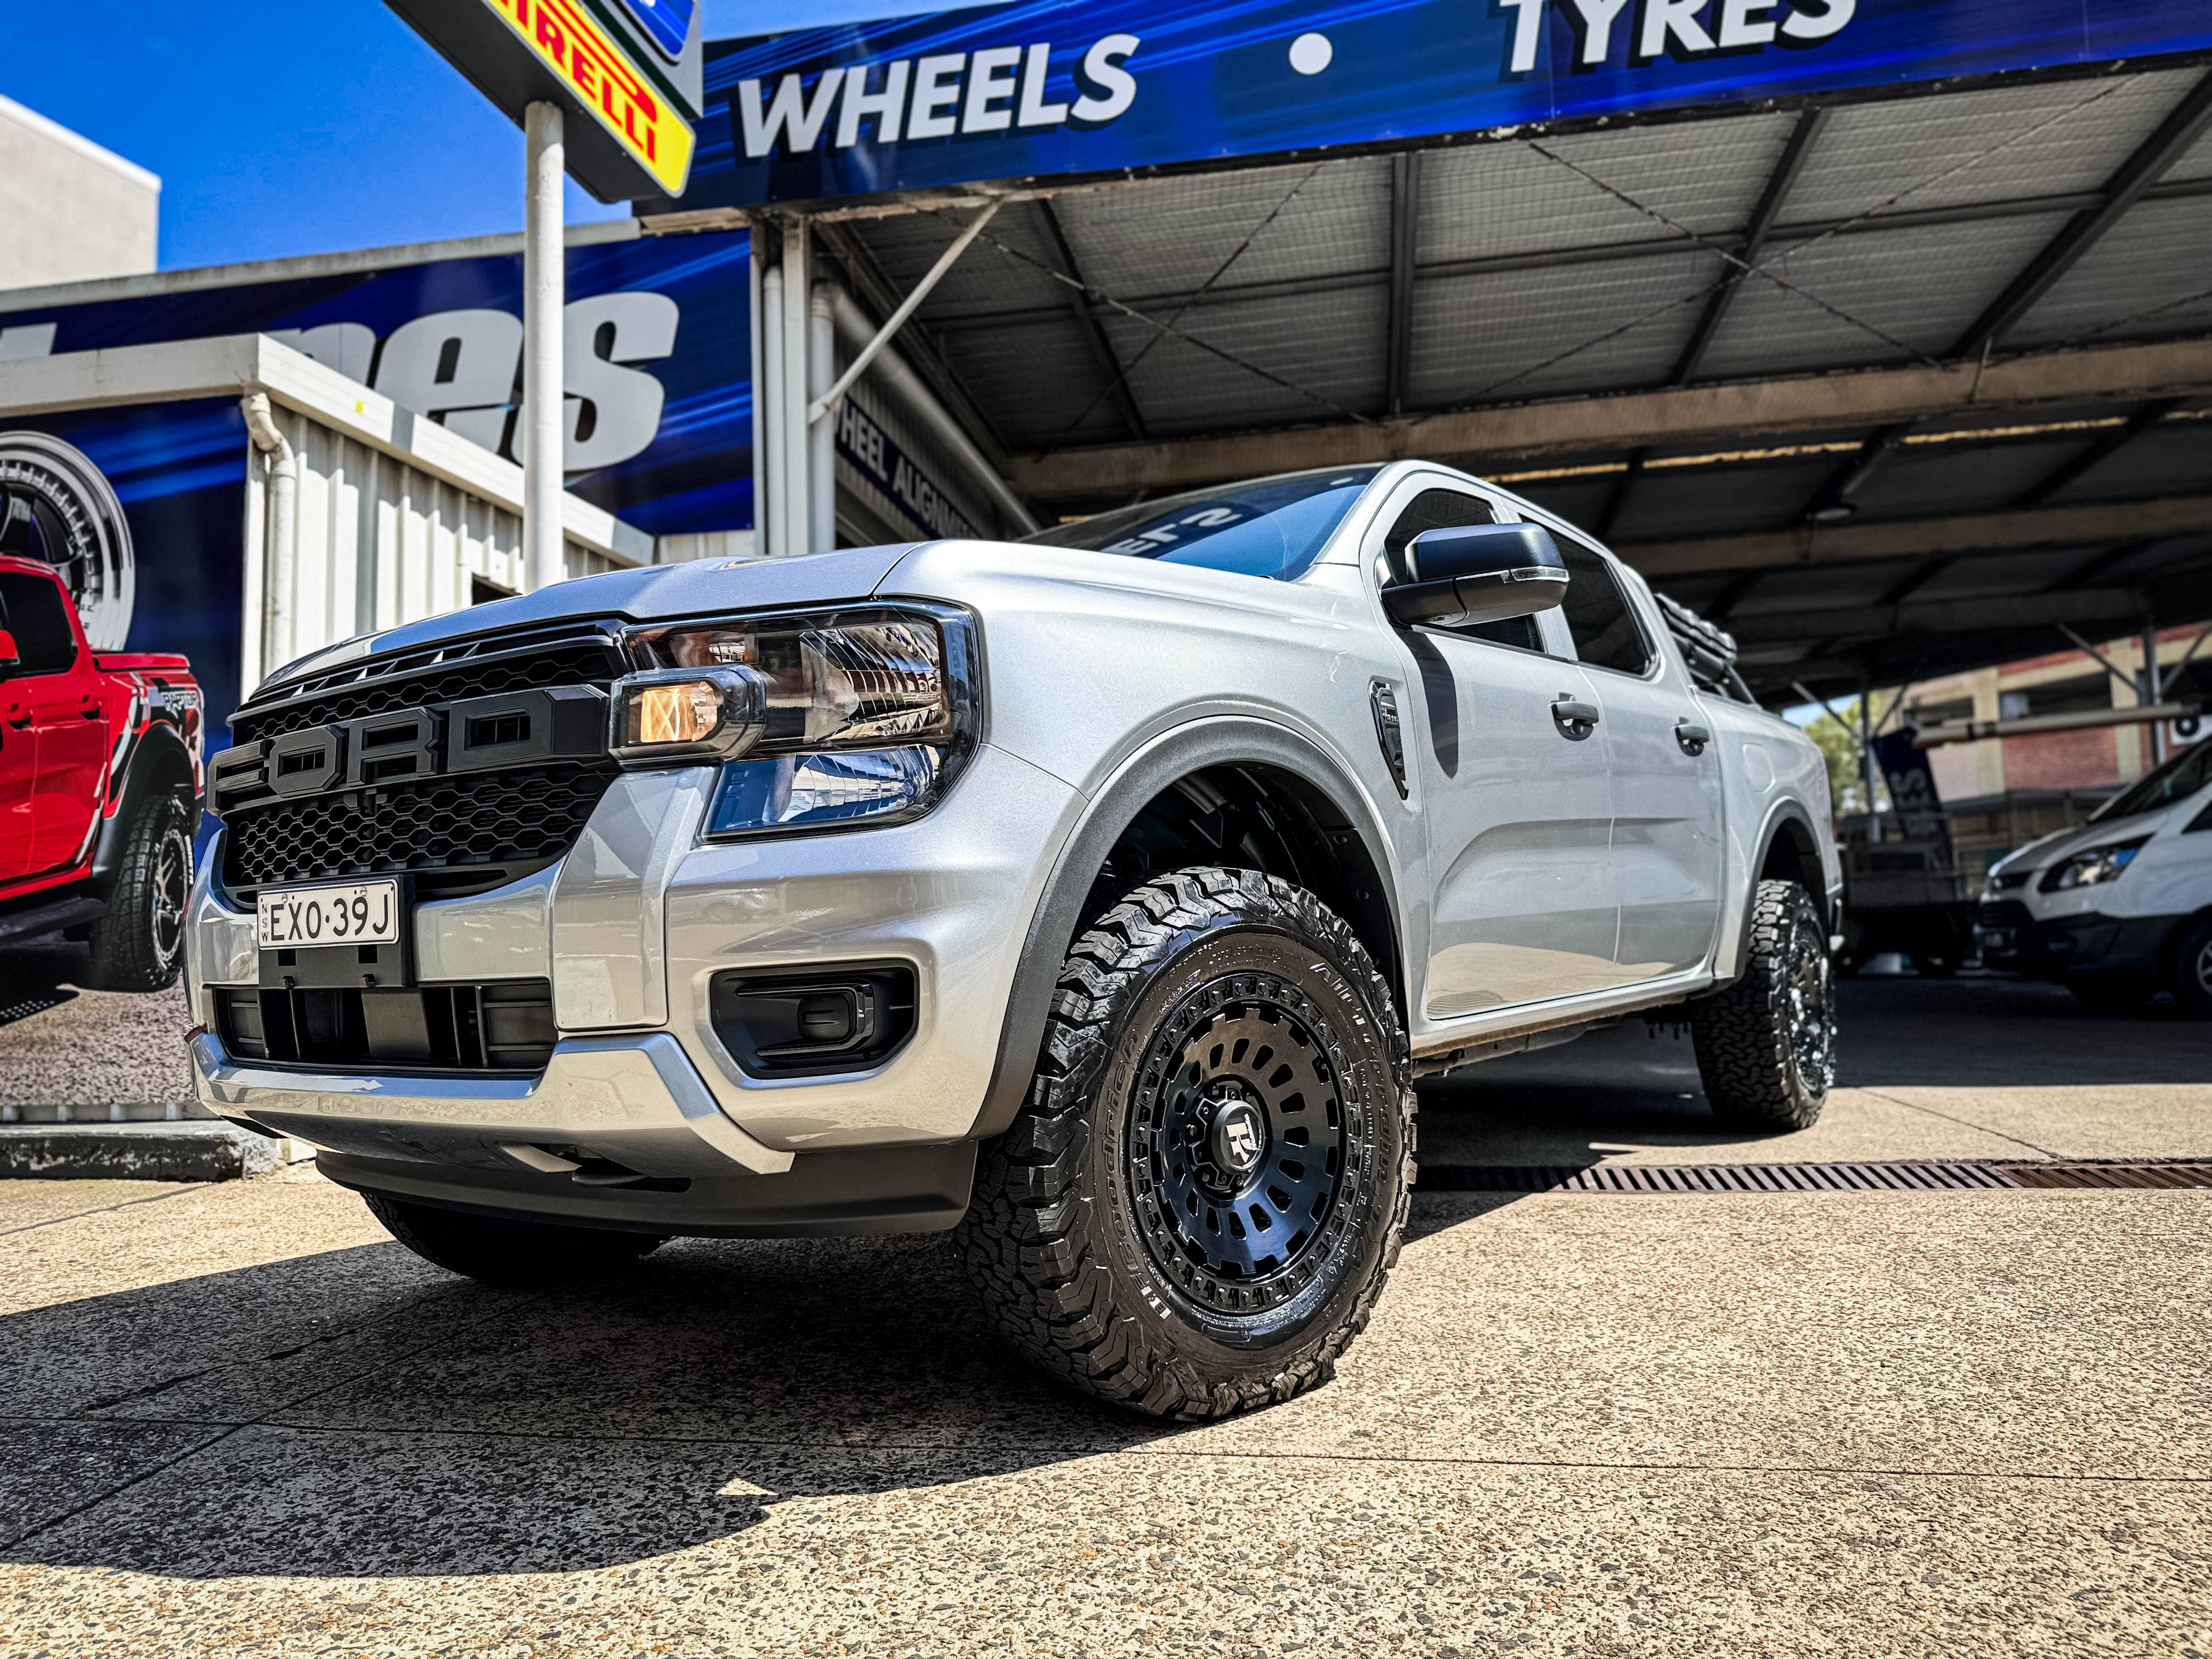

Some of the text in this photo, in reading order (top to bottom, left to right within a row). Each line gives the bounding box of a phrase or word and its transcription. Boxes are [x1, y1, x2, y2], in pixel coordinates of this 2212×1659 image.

[738, 33, 1141, 157] WHEELS
[839, 398, 889, 483] HEEL
[206, 689, 554, 816] FORD
